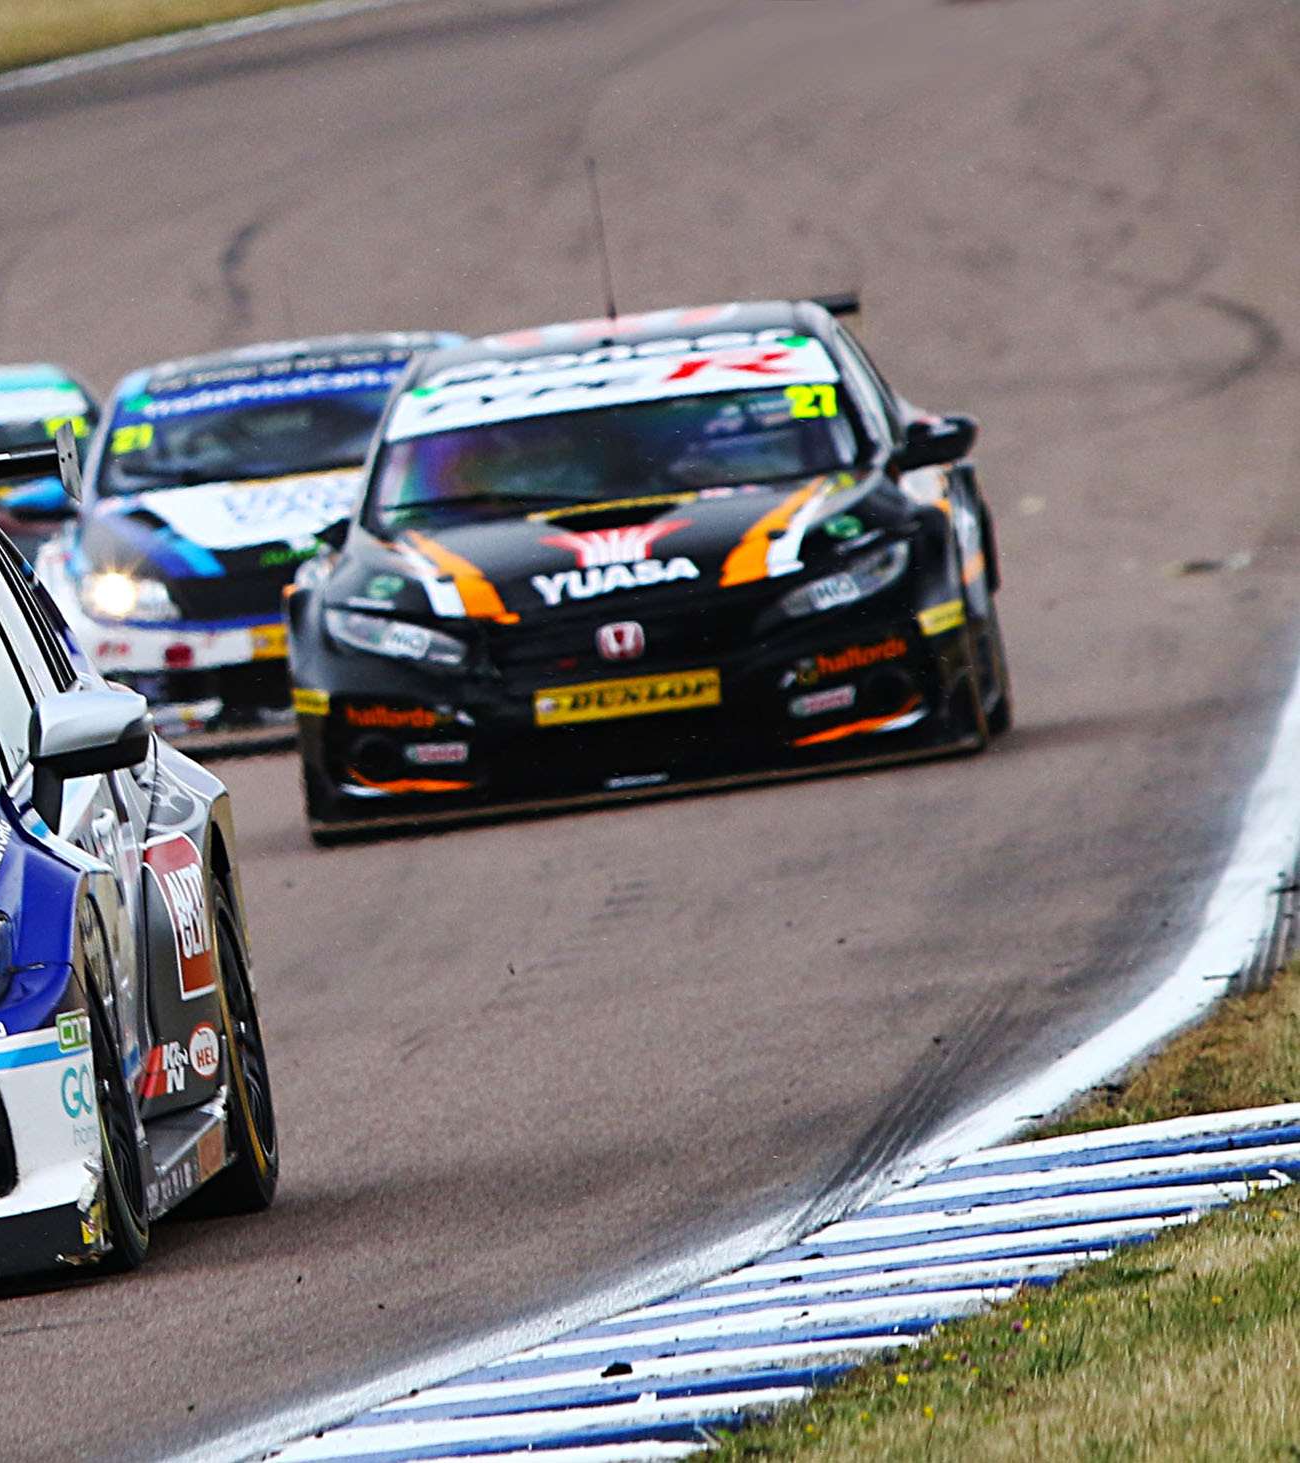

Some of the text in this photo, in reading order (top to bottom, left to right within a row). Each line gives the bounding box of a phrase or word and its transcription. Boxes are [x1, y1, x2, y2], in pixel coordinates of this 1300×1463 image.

[783, 384, 838, 418] 27
[531, 556, 700, 606] YUASA
[570, 681, 717, 712] DUNLOP
[195, 1045, 218, 1068] HEL
